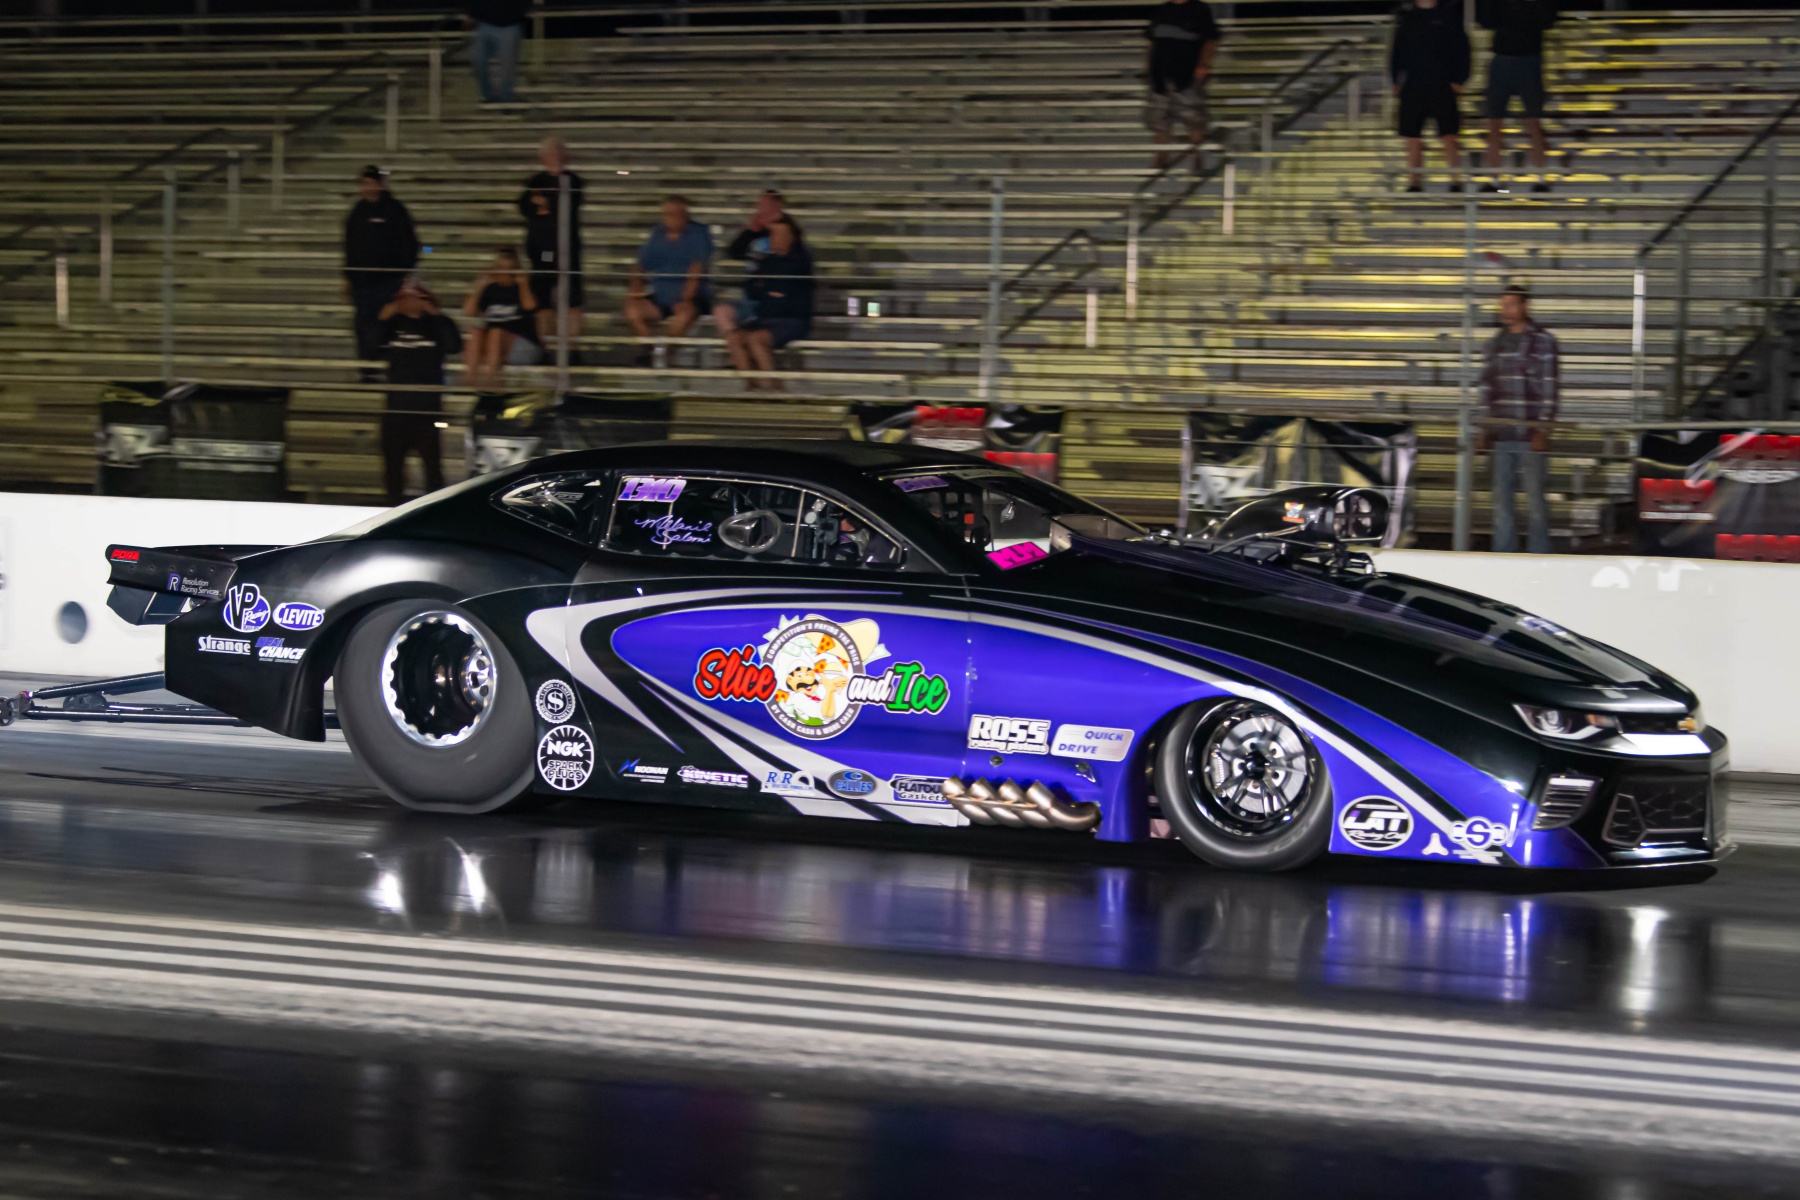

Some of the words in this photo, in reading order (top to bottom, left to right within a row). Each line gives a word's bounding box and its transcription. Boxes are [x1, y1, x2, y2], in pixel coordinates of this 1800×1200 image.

[168, 575, 180, 591] R
[182, 577, 209, 586] Resolution
[181, 584, 198, 595] Racing
[198, 586, 220, 596] Services
[229, 583, 260, 631] VP
[273, 603, 325, 626] CLEVITE
[244, 609, 269, 625] Racing
[199, 635, 251, 655] Strange
[766, 623, 813, 660] COMPETITION'S
[813, 623, 840, 636] PAYING
[838, 632, 851, 646] THE
[847, 645, 860, 666] PRICE
[259, 646, 306, 660] CHANCE
[695, 645, 777, 701] Slice
[848, 669, 893, 701] and
[887, 663, 948, 712] Ice
[770, 704, 780, 715] BY
[778, 712, 796, 729] CASH
[796, 725, 815, 735] CASH
[823, 722, 841, 734] MORE
[839, 708, 855, 723] CASH
[970, 715, 1050, 745] ROSS
[1084, 730, 1125, 742] QUICK
[547, 741, 586, 757] NGK
[970, 739, 1006, 752] racing
[1058, 742, 1099, 755] DRIVE
[547, 760, 584, 771] SPARK
[547, 769, 583, 780] PLUGS
[683, 769, 749, 784] KINETIC
[898, 780, 944, 794] FLATOU
[899, 791, 947, 801] Gaskets
[1342, 810, 1410, 832] LAT
